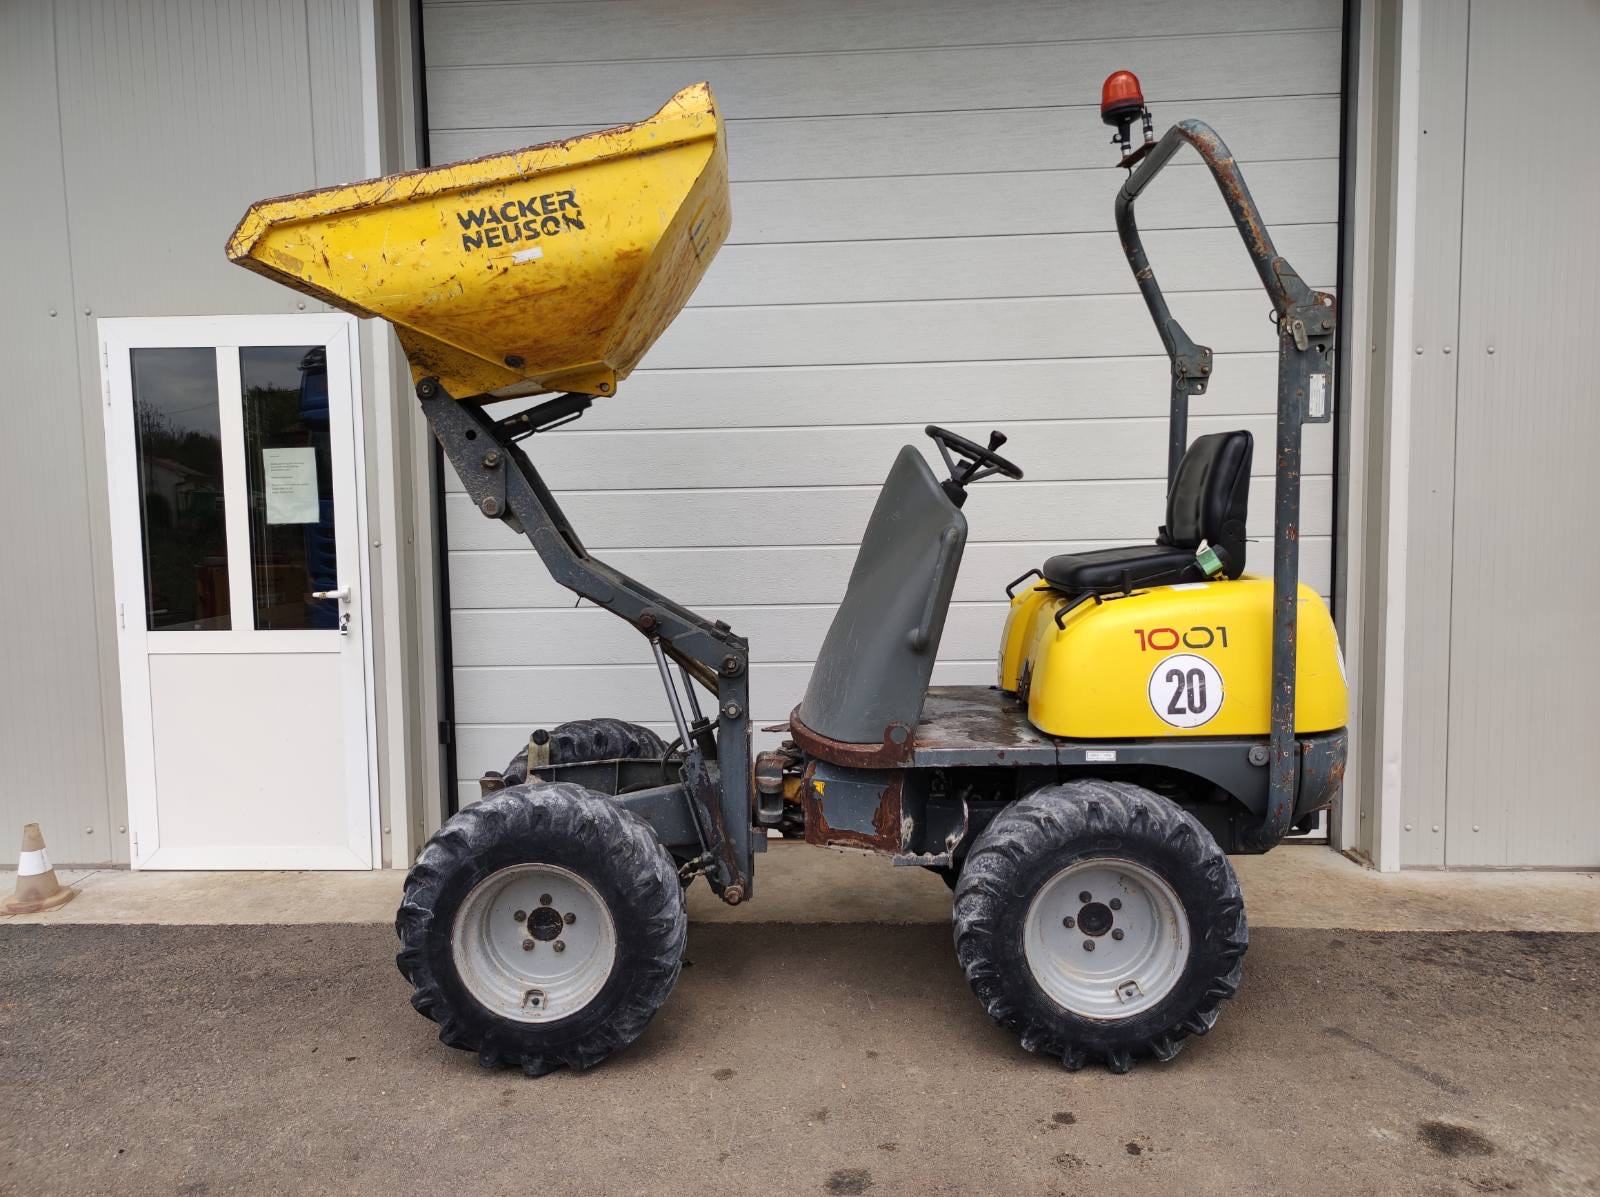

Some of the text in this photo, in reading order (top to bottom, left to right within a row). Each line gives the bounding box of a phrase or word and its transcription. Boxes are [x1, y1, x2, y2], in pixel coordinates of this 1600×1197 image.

[456, 190, 582, 230] WACKER
[462, 209, 586, 252] NEUSON
[1134, 626, 1229, 651] 1001
[1165, 667, 1207, 715] 20
